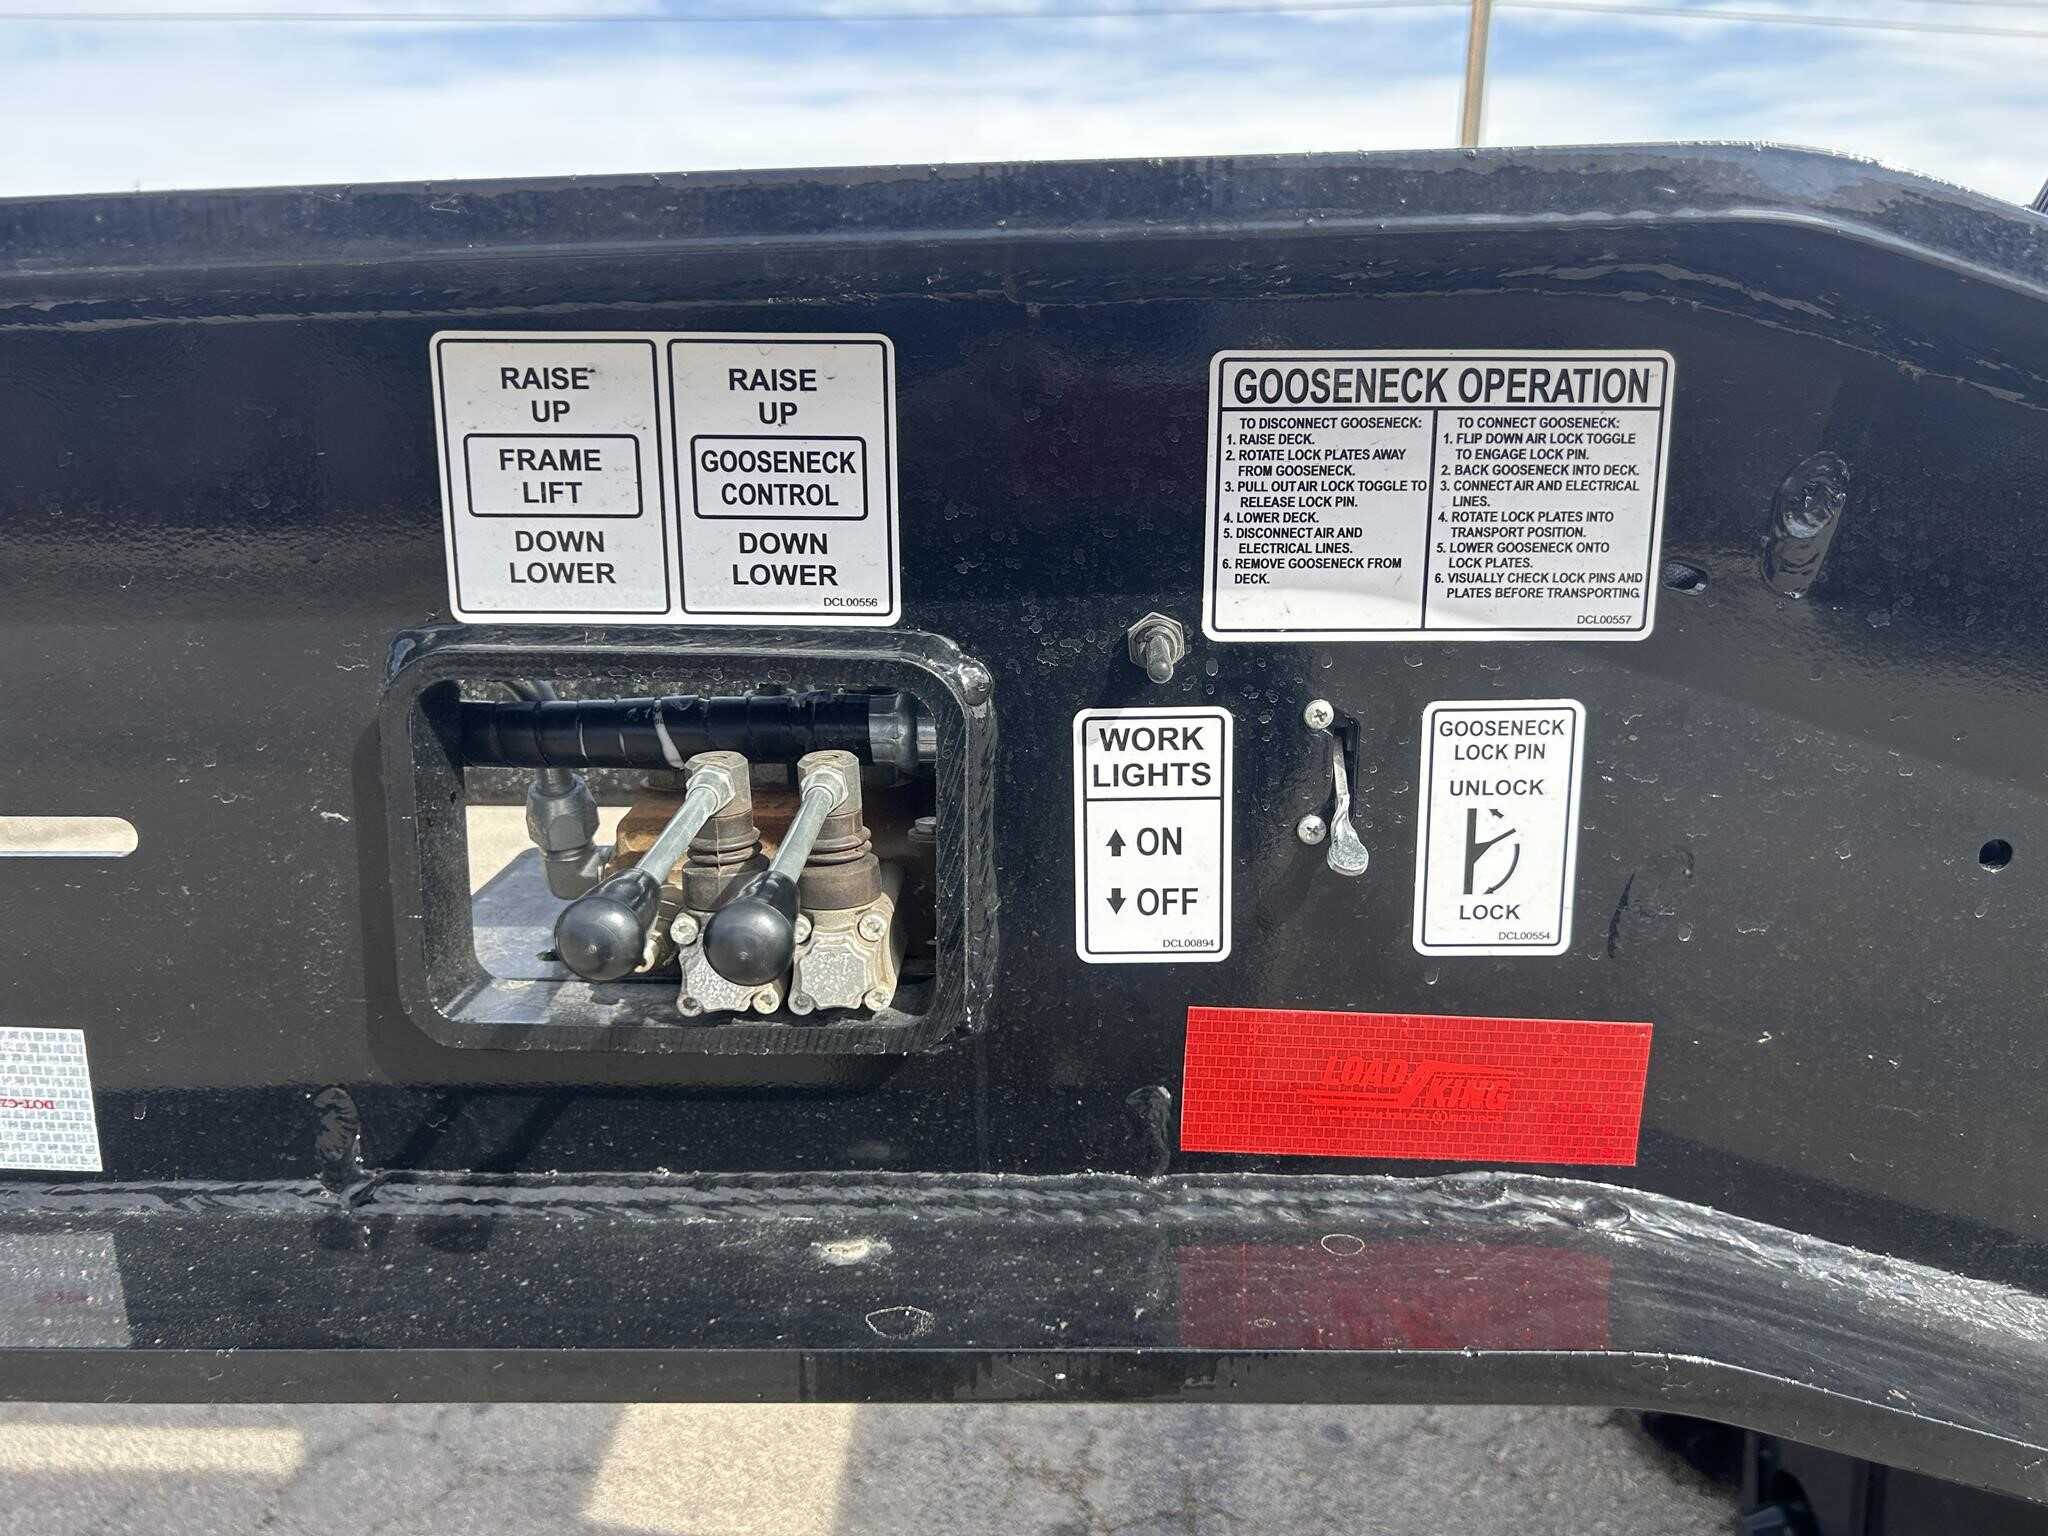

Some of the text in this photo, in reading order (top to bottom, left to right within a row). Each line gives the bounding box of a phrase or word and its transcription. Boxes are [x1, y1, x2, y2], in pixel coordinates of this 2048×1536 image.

[500, 367, 590, 390] RAISE
[728, 368, 817, 392] RAISE
[1234, 367, 1650, 404] GOOSENECK OPERATION
[531, 400, 571, 423] UP
[759, 401, 798, 425] UP
[1240, 417, 1422, 429] TO DISCONNECT GOOSENECK:
[1457, 417, 1620, 428] TO CONNECT GOOSENECK:
[1227, 434, 1315, 445] 1. RAISE DECK.
[1443, 433, 1635, 444] 1. FLIP DOWN AIR LOCK TOGGLE
[499, 449, 602, 472] FRAME
[1226, 449, 1406, 461] 2. ROTATE LOCK PLATES AWAY
[1456, 449, 1589, 460] TO ENGAGE LOCK PIN.
[701, 451, 856, 473] GOOSENECK
[1238, 465, 1356, 477] FROM GOOSENECK.
[1441, 464, 1639, 476] 2. BACK GOOSENECK INTO DECK.
[1225, 481, 1427, 492] 3. PULL OUT AIR LOCK TOGGLE TO
[1440, 481, 1640, 491] 3. CONNECT AIR AND ELECTRICAL
[523, 482, 582, 504] LIFT
[721, 483, 839, 506] CONTROL
[1240, 497, 1358, 507] RELEASE LOCK PIN.
[1453, 496, 1490, 507] LINES.
[1224, 513, 1319, 523] 4. LOWER DECK.
[1438, 511, 1614, 522] 4. ROTATE LOCK PLATES INTO
[1224, 528, 1363, 539] 5. DISCONNECT AIR AND
[1451, 527, 1586, 538] TRANSPORT POSITION.
[515, 530, 605, 553] DOWN
[739, 533, 827, 555] DOWN
[1437, 542, 1610, 553] 5. LOWER GOOSENECK ONTO
[1239, 543, 1353, 554] ELECTRICAL LINES.
[1223, 558, 1402, 569] 6. REMOVE GOOSENECK FROM
[1449, 558, 1533, 568] LOCK PLATES.
[510, 562, 616, 584] LOWER
[732, 565, 838, 586] LOWER
[1234, 574, 1270, 584] DECK.
[1434, 573, 1642, 583] 6. VISUALLY CHECK LOCK PINS AND
[1447, 588, 1492, 598] PLATES
[1495, 588, 1544, 598] BEFORE
[823, 598, 878, 607] DCL00556
[1577, 616, 1631, 625] DCL00557
[1439, 720, 1565, 736] GOOSENECK
[1100, 726, 1205, 752] WORK
[1455, 744, 1546, 760] LOCK PIN
[1093, 762, 1211, 787] LIGHTS
[1450, 779, 1544, 796] UNLOCK
[1136, 827, 1182, 856] ON
[1137, 888, 1198, 916] OFF
[1460, 904, 1520, 920] LOCK
[1163, 939, 1214, 948] DCL00894
[1323, 1056, 1511, 1110] LOAD KING
